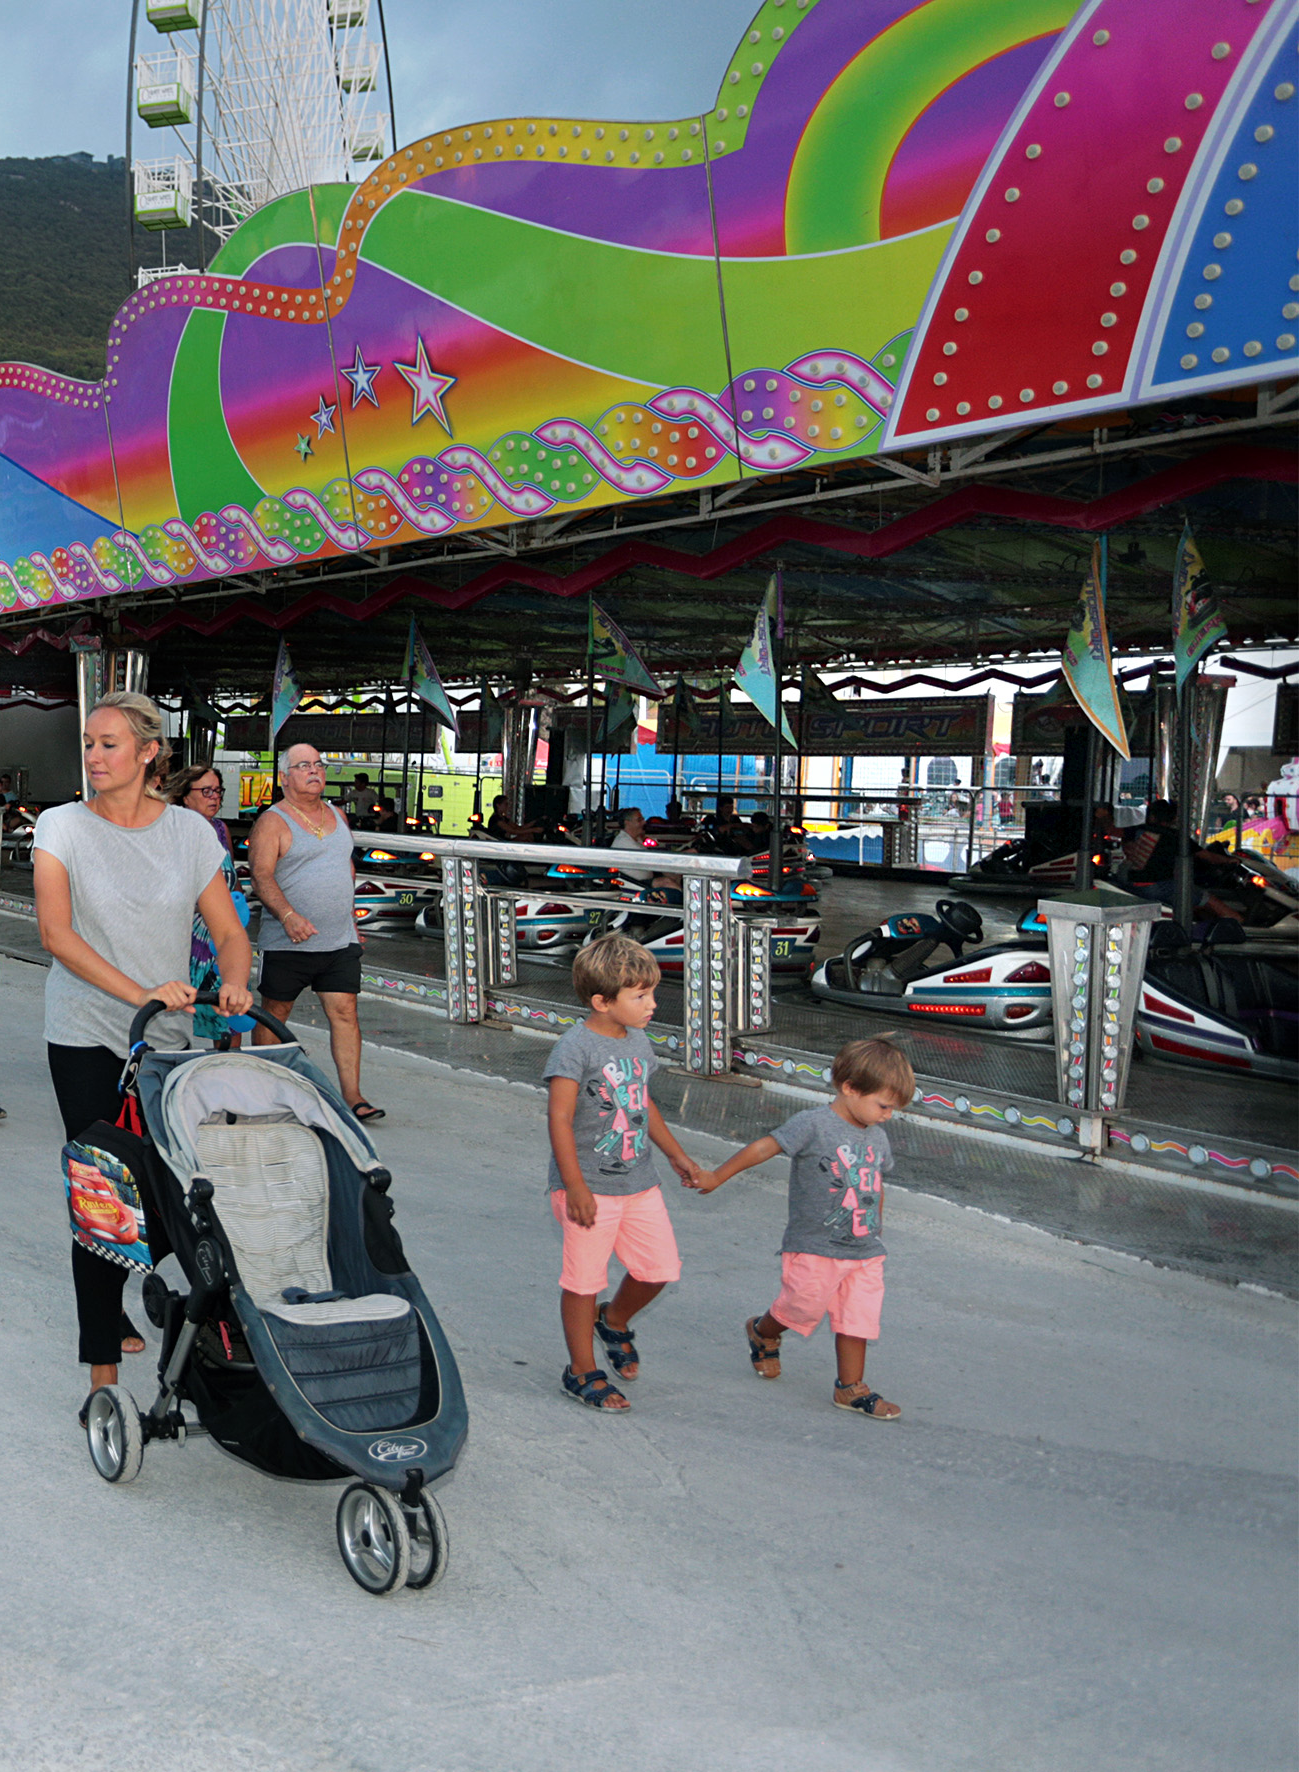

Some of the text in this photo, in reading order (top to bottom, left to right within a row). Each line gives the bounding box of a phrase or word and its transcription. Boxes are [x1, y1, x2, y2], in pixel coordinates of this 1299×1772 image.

[809, 713, 960, 739] SPORT
[399, 893, 414, 905] 30
[589, 911, 601, 924] 27
[775, 941, 789, 956] 31
[611, 1108, 630, 1131] A
[377, 1441, 408, 1460] City
